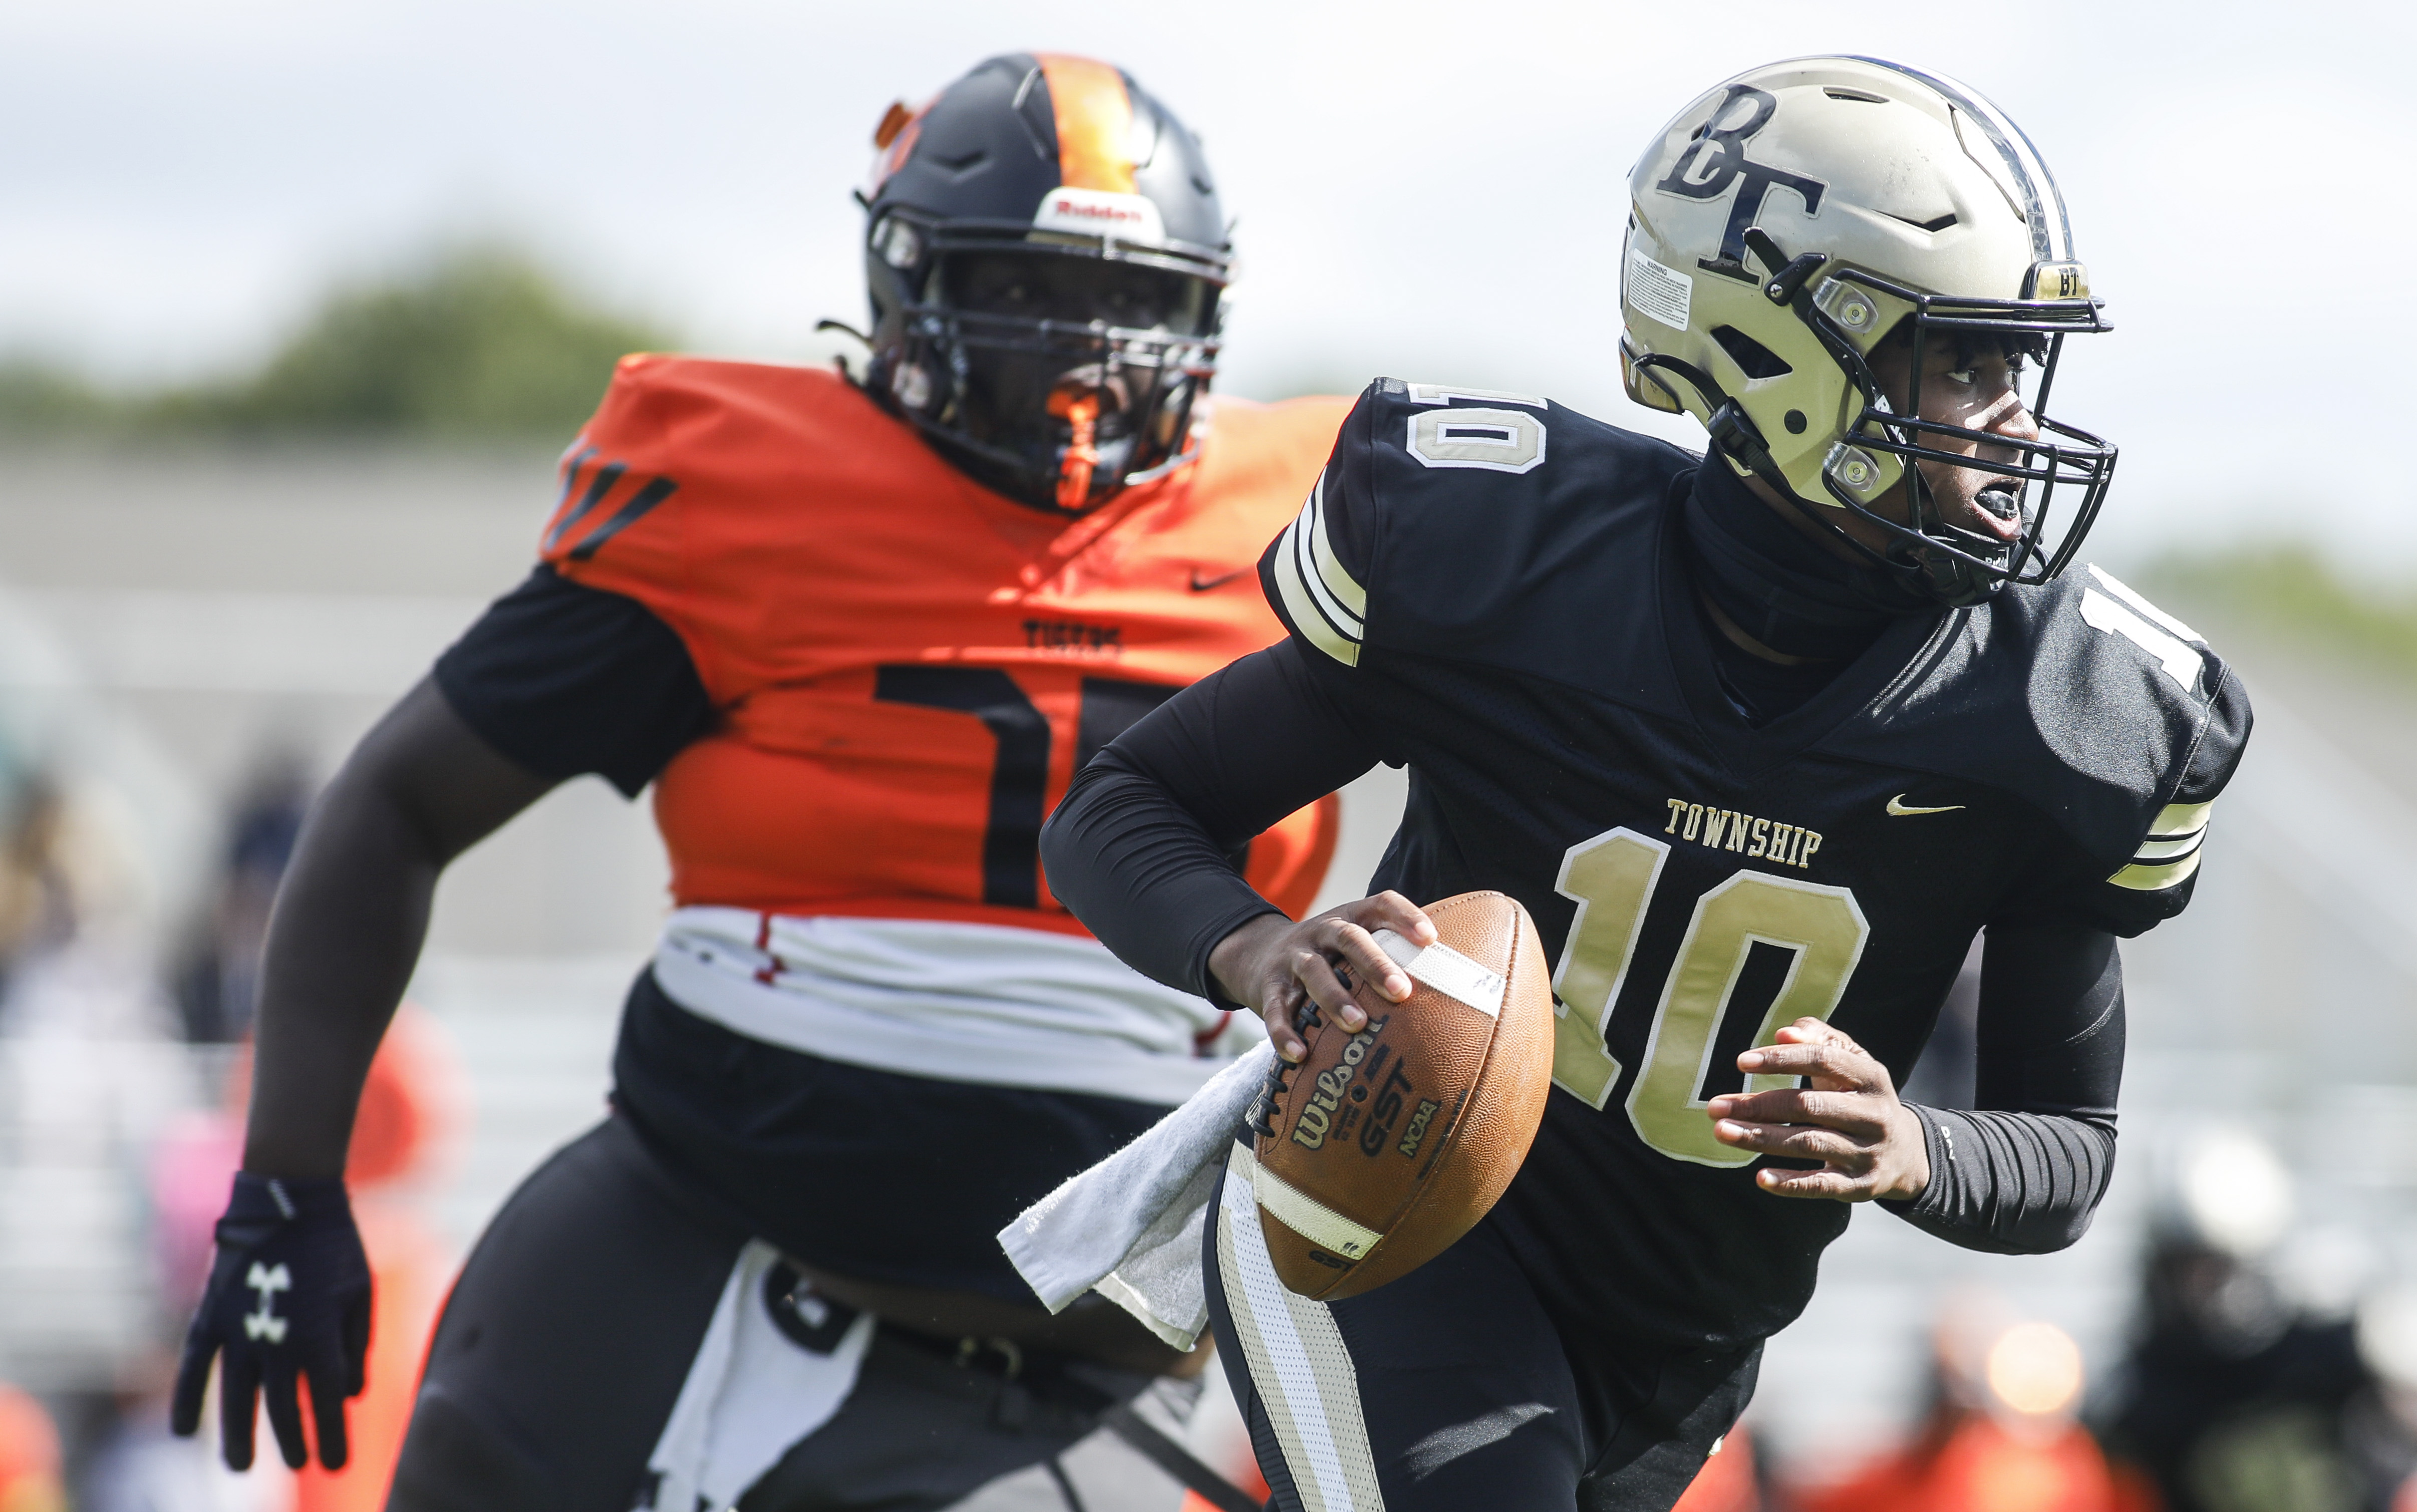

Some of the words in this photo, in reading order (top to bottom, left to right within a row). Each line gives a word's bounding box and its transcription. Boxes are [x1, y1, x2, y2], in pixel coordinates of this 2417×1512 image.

[1656, 82, 1827, 289] BT
[1647, 259, 1668, 276] WARNING
[2058, 267, 2079, 296] BT
[1664, 798, 1823, 868] TOWNSHIP
[1552, 825, 1871, 1168] 10
[1292, 1018, 1384, 1150] Wilson
[1360, 1058, 1412, 1157] GST
[1398, 1099, 1439, 1157] NCAA
